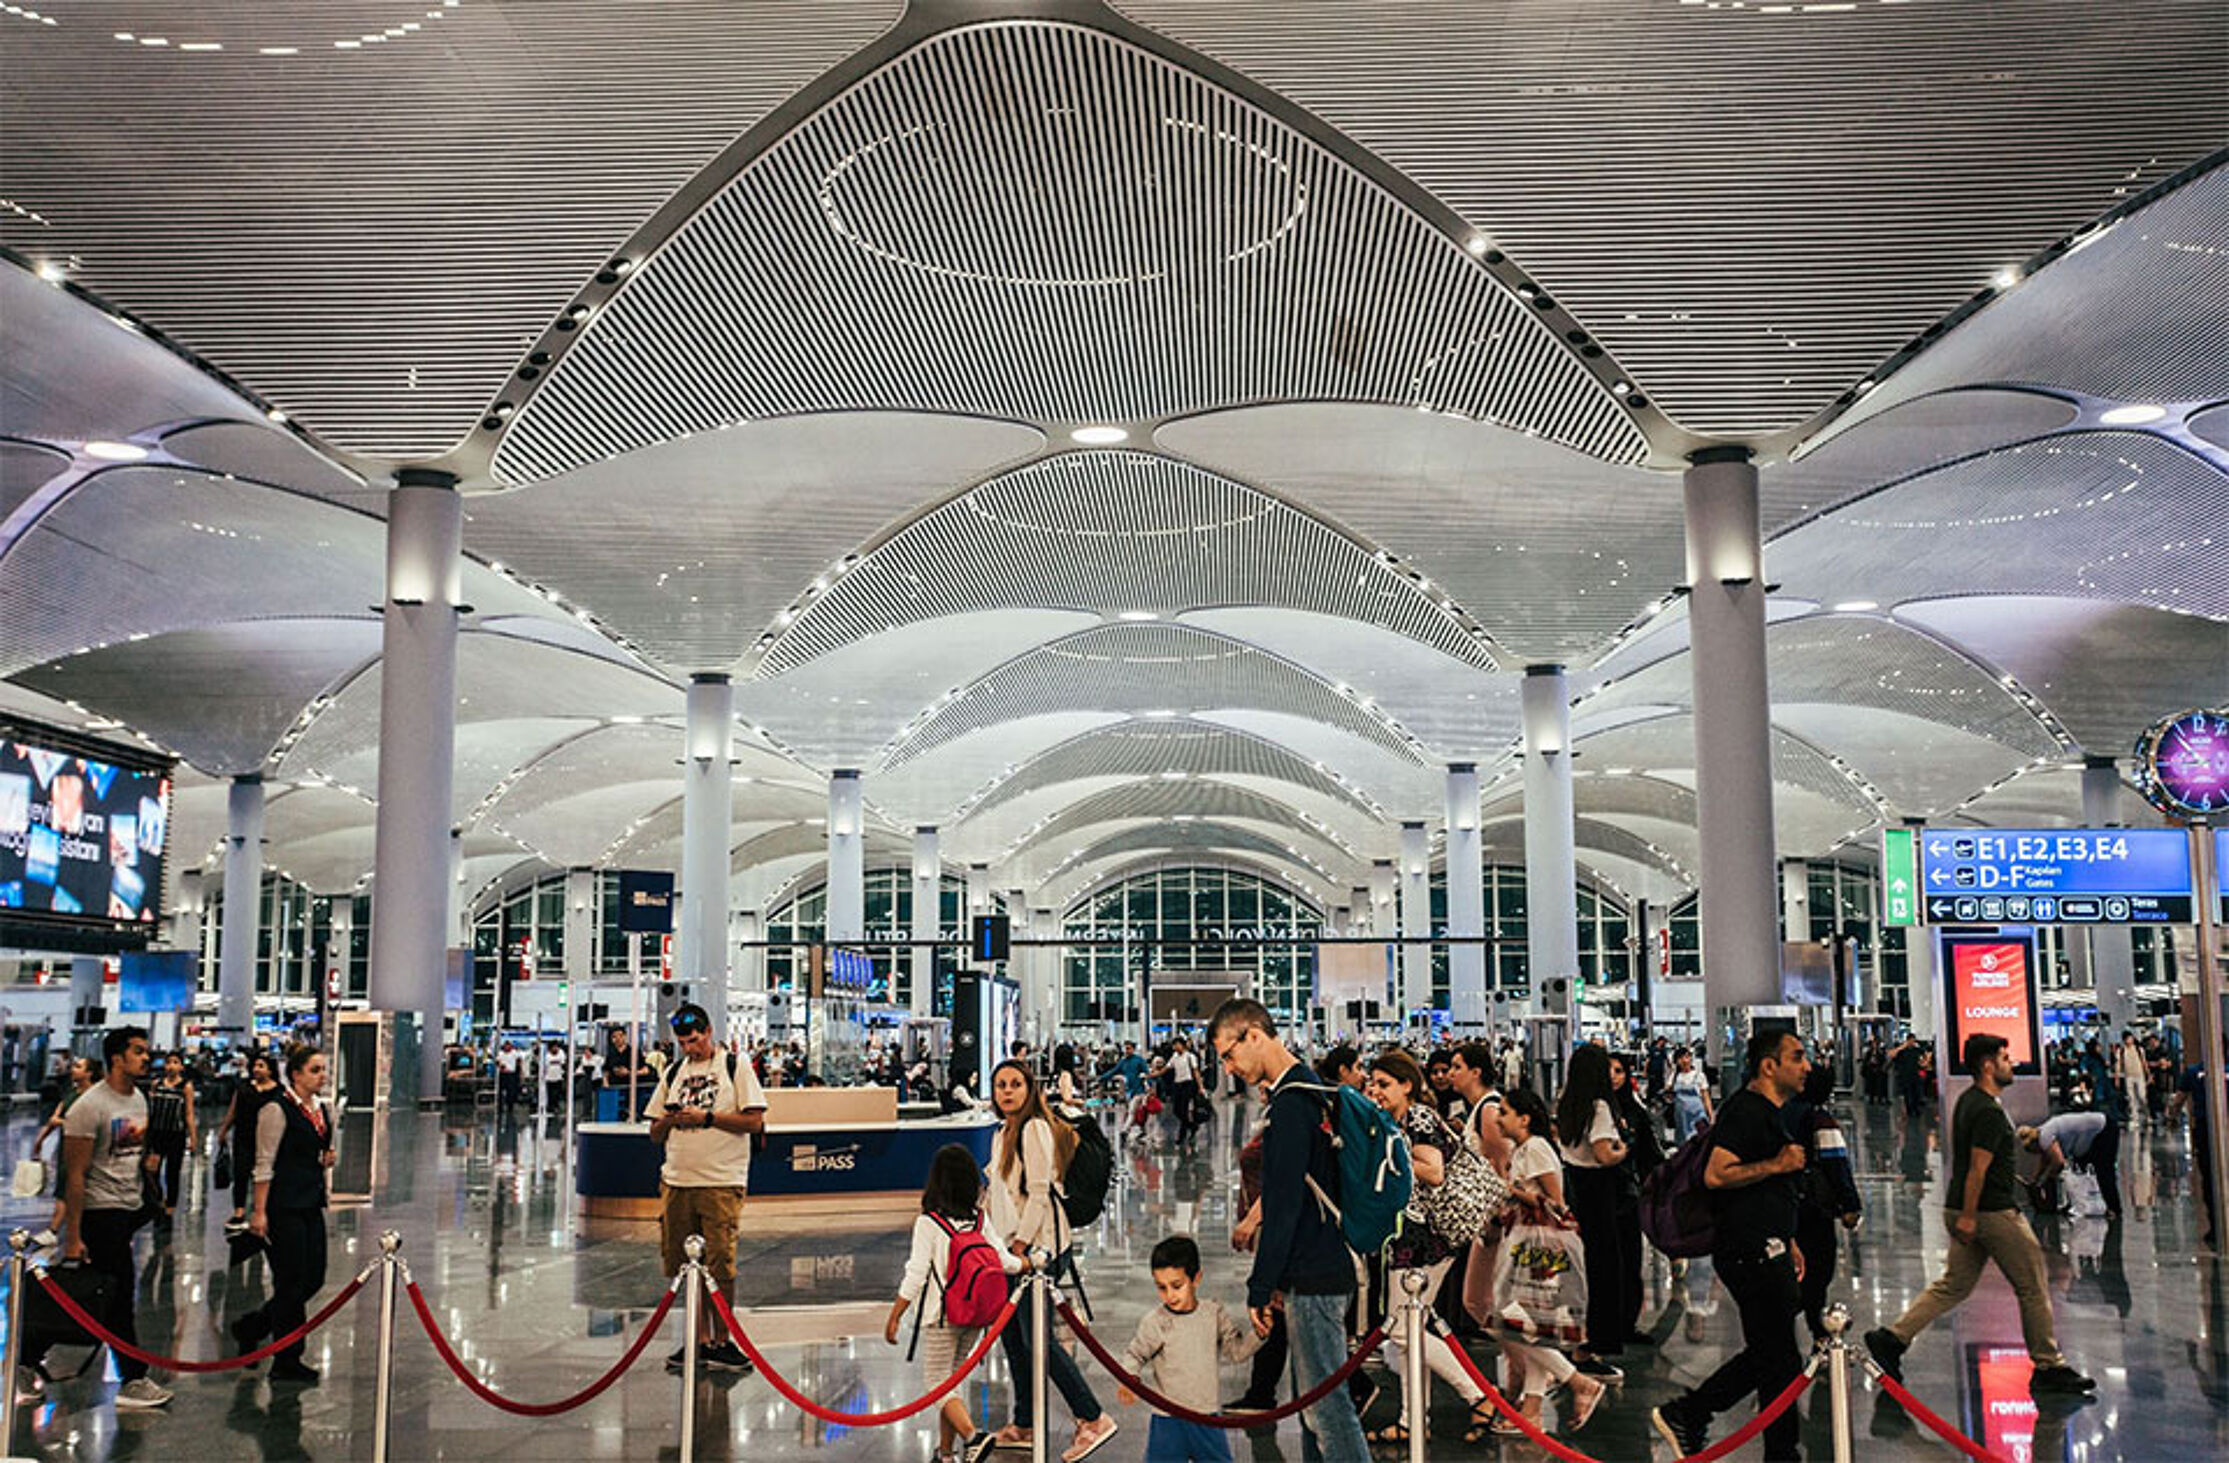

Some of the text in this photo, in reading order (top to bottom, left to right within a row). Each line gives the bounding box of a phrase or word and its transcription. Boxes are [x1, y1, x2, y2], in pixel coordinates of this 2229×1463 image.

[1978, 837, 2129, 863] E1,E2,E3,E4
[1980, 865, 2024, 888] D-F
[1965, 1006, 2019, 1018] LOUNGE
[819, 1154, 855, 1170] PASS
